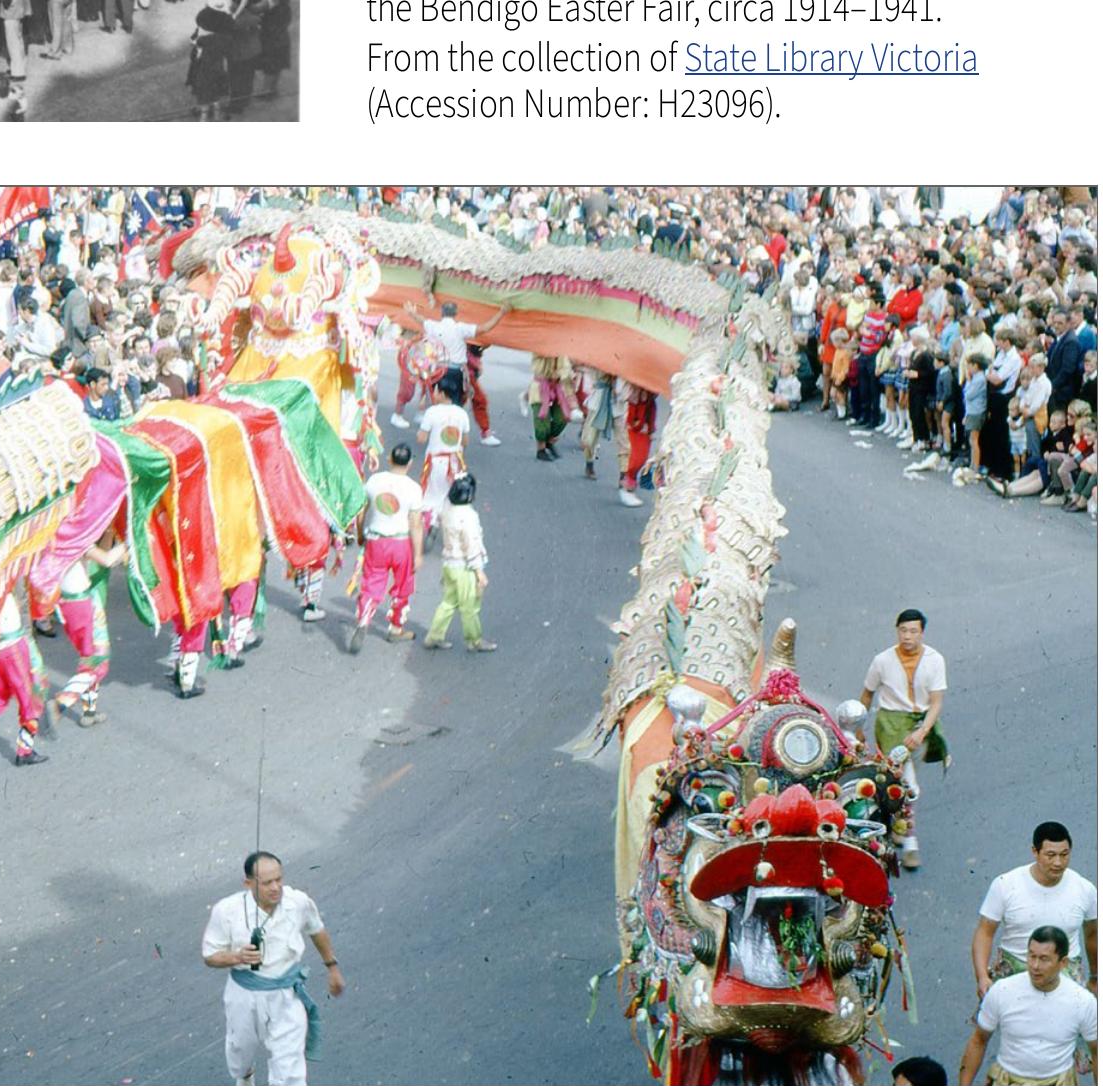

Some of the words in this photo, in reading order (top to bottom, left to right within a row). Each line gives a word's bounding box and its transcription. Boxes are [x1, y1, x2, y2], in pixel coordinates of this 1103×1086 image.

[366, 0, 412, 23] the
[421, 0, 538, 32] Bendigo
[548, 0, 635, 23] Easter
[643, 0, 700, 28] Fair,
[708, 0, 774, 23] circa
[784, 0, 942, 23] 1914–1941.
[368, 42, 439, 73] From
[447, 40, 494, 73] the
[502, 40, 640, 73] collection
[650, 39, 679, 73] of
[685, 42, 757, 73] State
[766, 40, 864, 81] Library
[870, 42, 977, 73] Victoria
[368, 86, 514, 125] (Accession
[525, 86, 649, 119] Number:
[659, 86, 781, 125] H23096).
